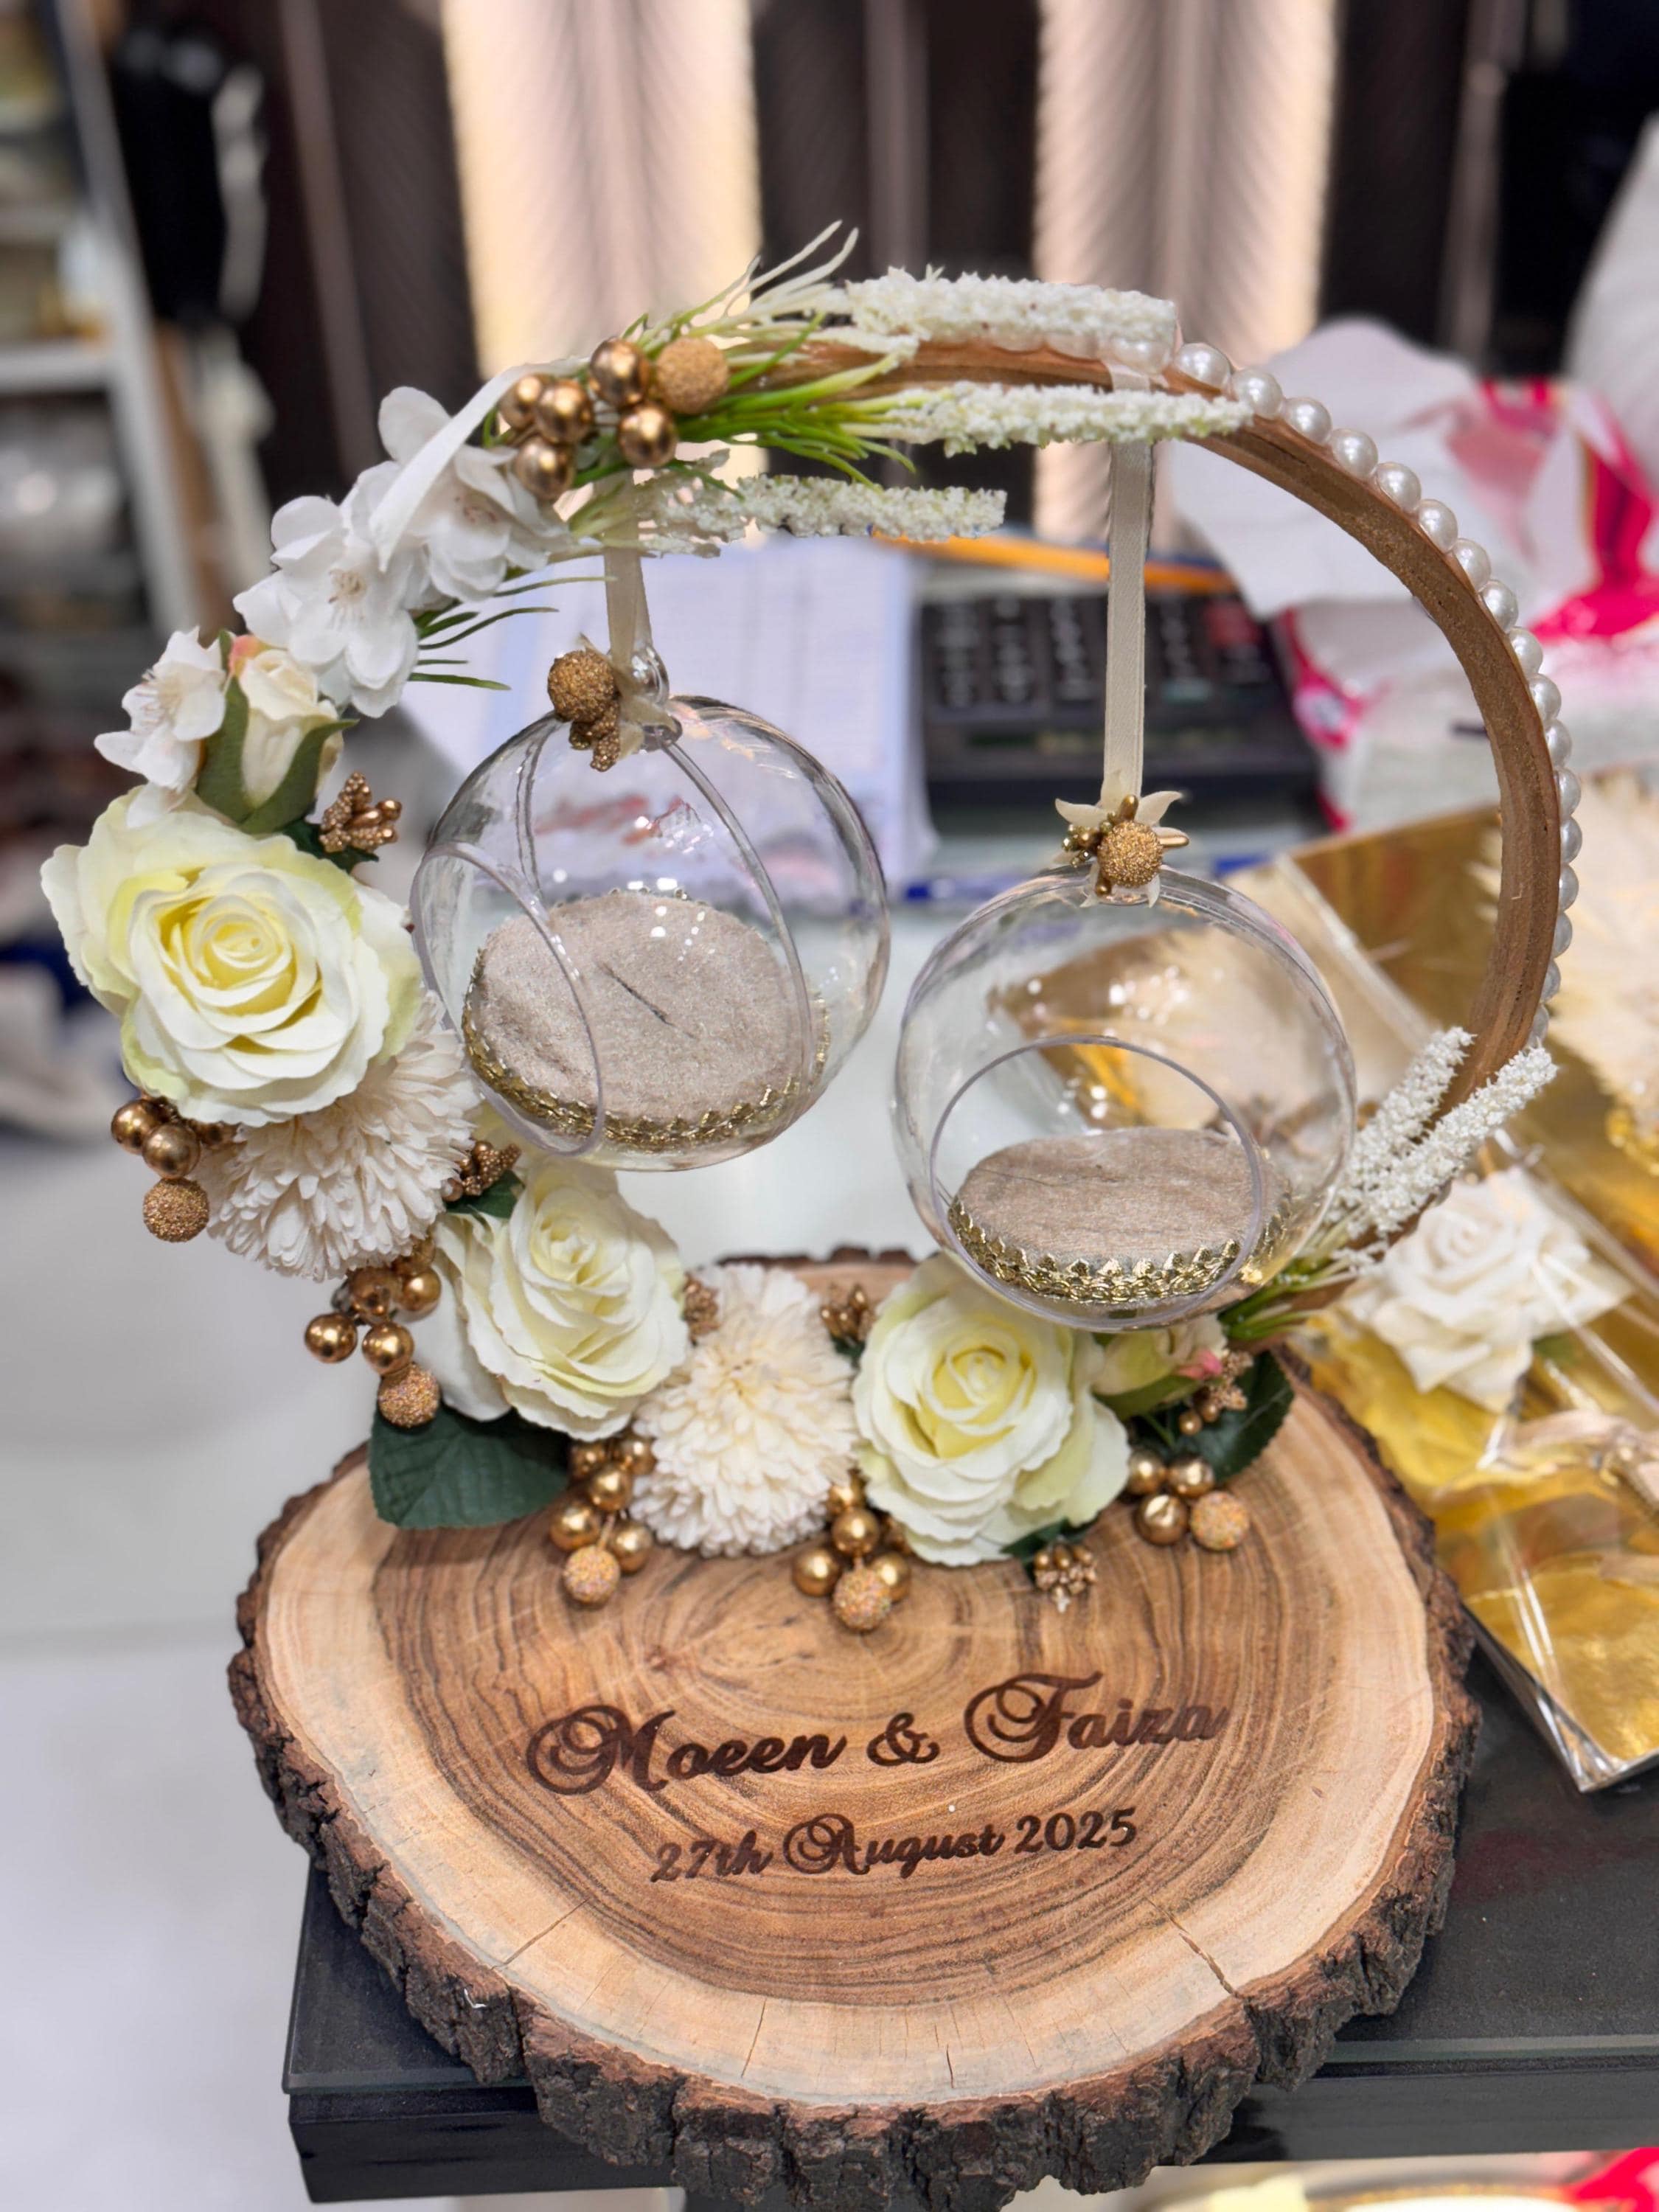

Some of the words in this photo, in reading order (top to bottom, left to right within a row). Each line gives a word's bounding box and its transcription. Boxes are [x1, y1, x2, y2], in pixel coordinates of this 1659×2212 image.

[526, 1704, 847, 1795] Moeen
[867, 1712, 939, 1767] &
[964, 1671, 1231, 1763] Faiza
[650, 1830, 772, 1883] 27th
[782, 1812, 1006, 1879] August
[1016, 1806, 1138, 1853] 2025
